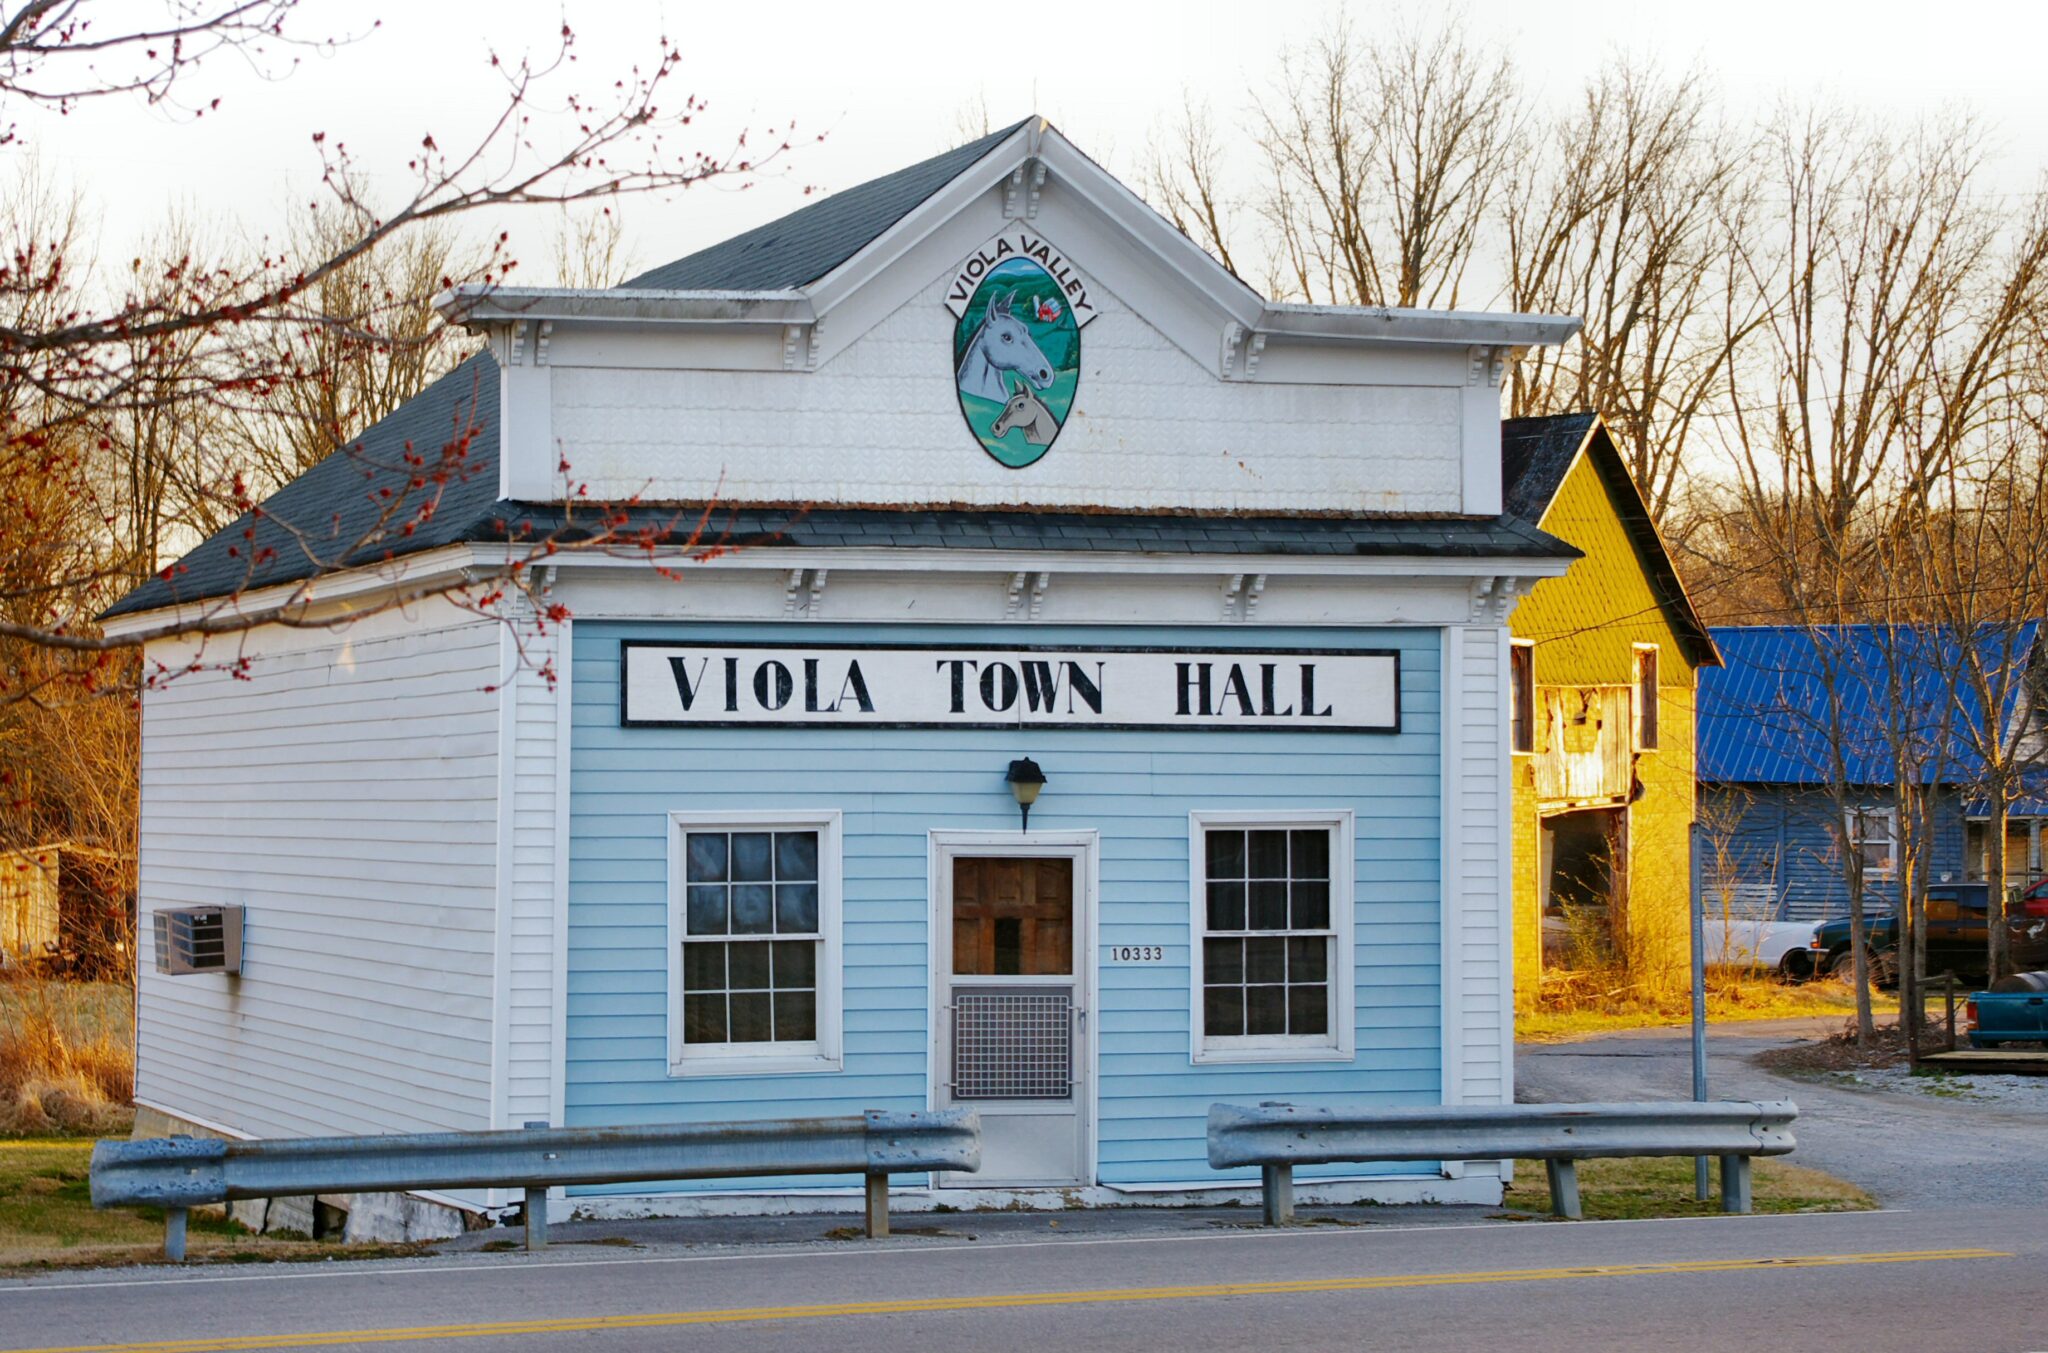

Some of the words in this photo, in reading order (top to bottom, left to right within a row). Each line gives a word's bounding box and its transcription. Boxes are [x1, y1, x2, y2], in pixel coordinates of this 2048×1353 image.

[950, 238, 1014, 301] VIOLA
[1020, 235, 1093, 311] VALLEY
[667, 656, 875, 713] VIOLA
[936, 660, 1106, 715] TOWN
[1174, 662, 1333, 717] HALL
[1112, 947, 1162, 961] 10333
